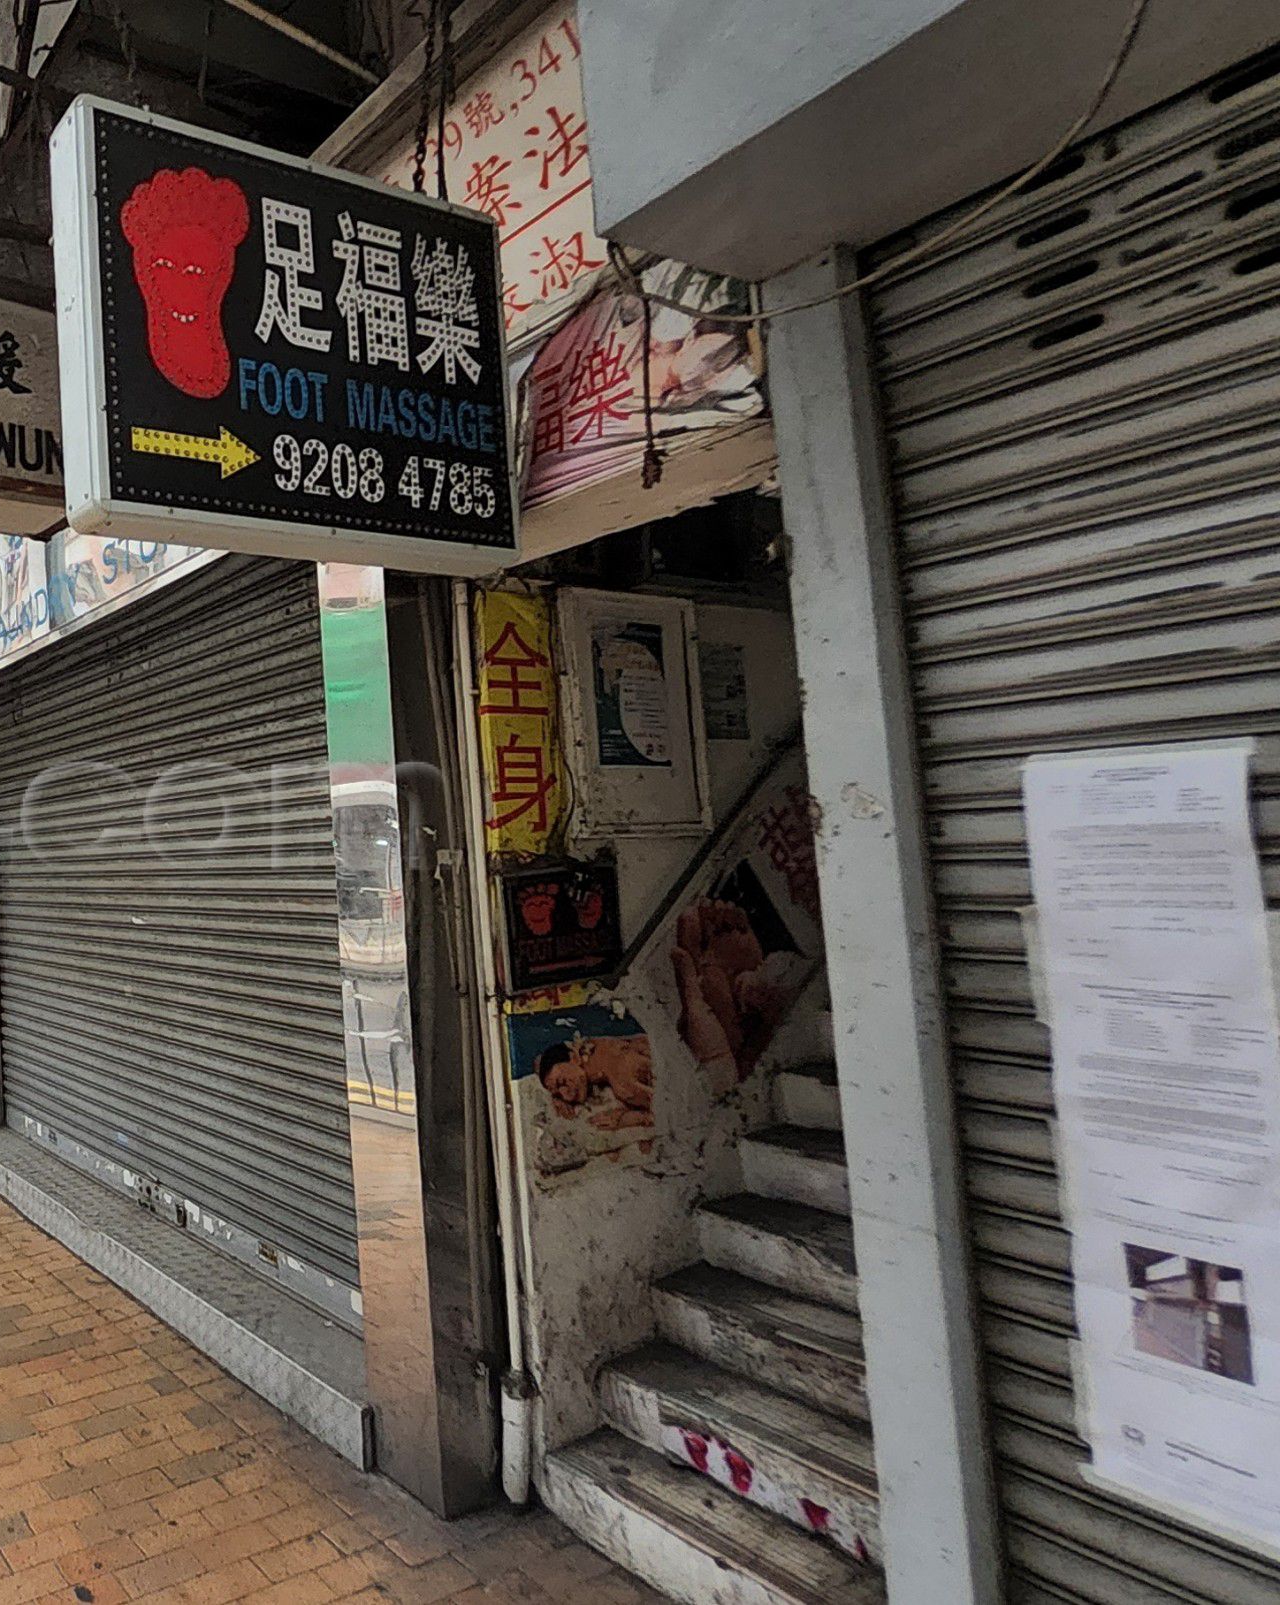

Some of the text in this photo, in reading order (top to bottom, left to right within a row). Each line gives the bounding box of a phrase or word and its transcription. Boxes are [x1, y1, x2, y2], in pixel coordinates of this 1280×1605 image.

[254, 197, 482, 384] 足福樂
[238, 358, 497, 452] FOOT MASSAGE
[273, 434, 496, 518] 9208 4785
[480, 621, 557, 833] 全身
